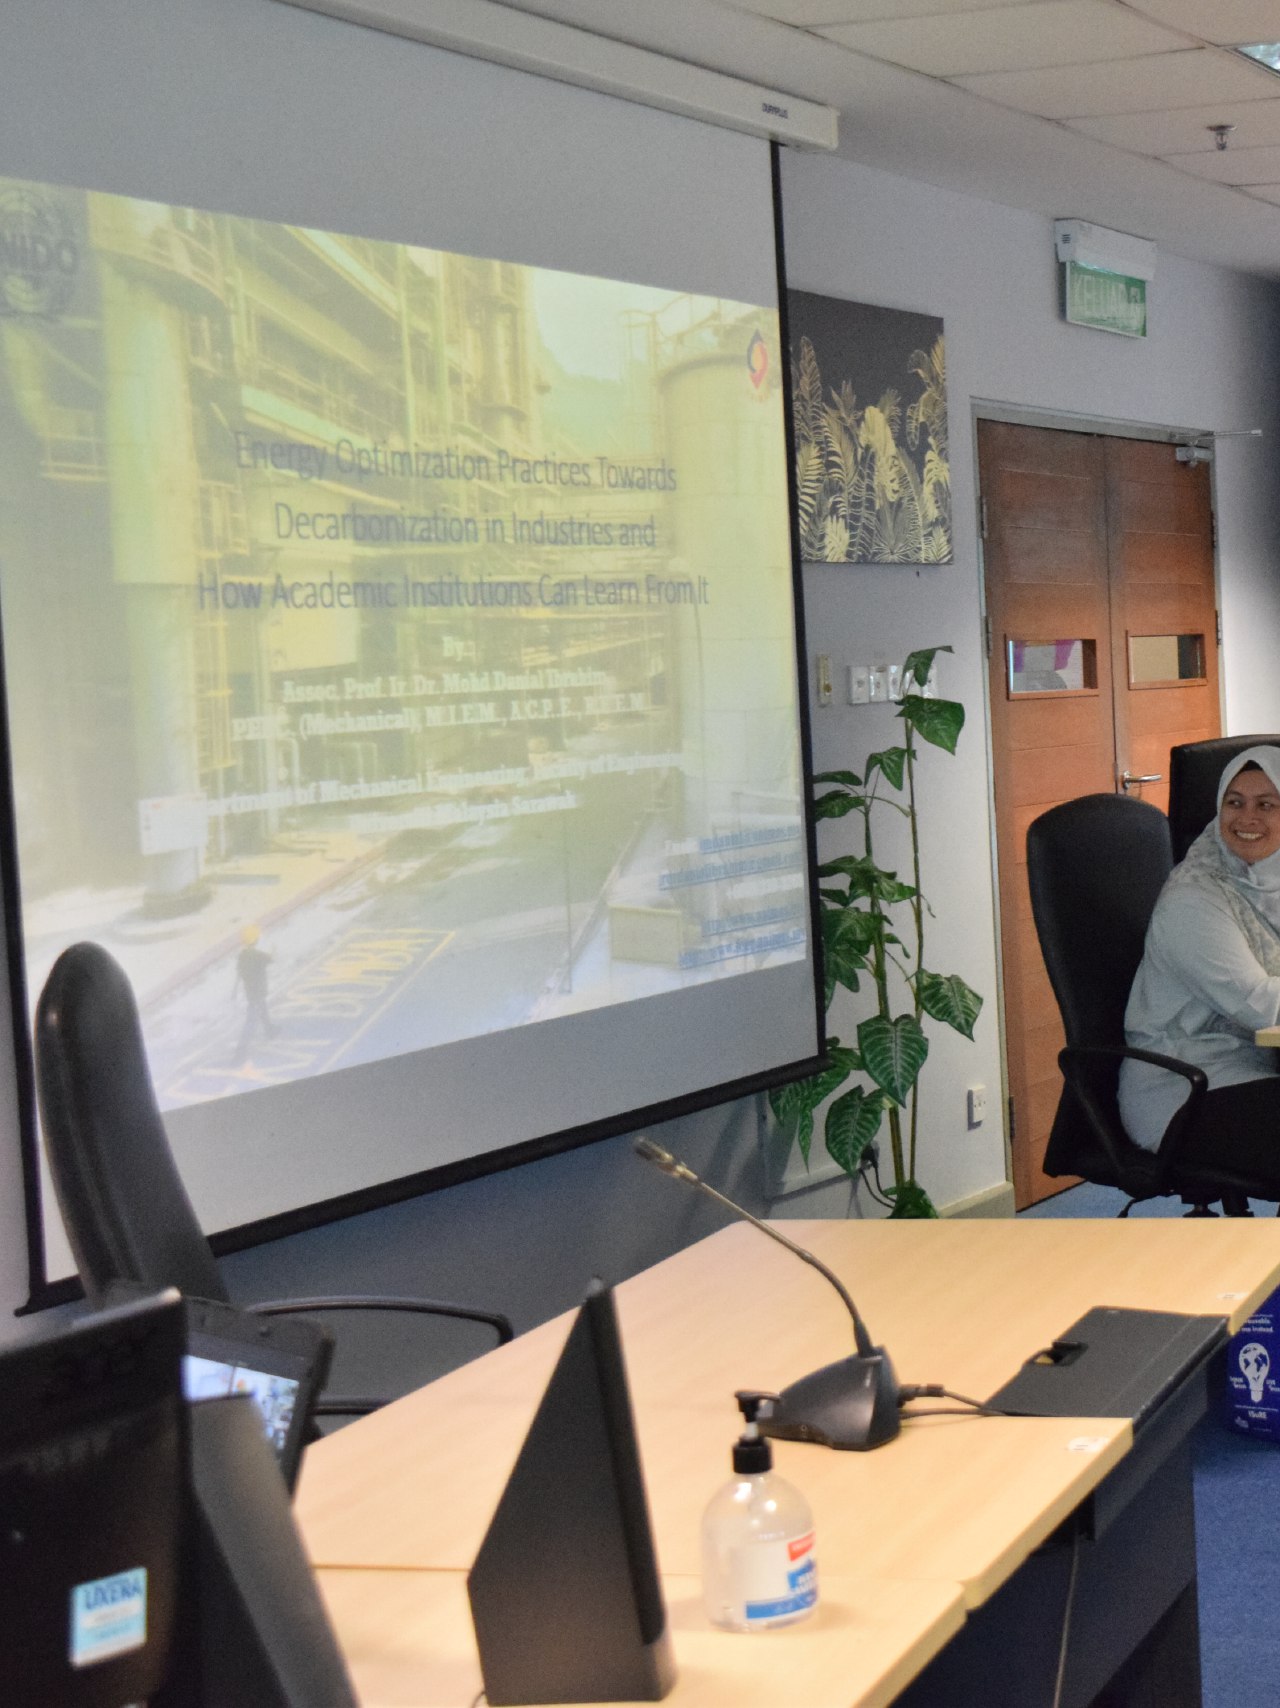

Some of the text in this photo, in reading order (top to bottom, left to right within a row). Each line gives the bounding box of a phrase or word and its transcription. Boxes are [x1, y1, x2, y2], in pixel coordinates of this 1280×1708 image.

[236, 431, 677, 491] Energy Optimization Practices Towards
[275, 501, 656, 548] Decarbonization in Industries and
[199, 570, 709, 609] How Academic Institutions Can Learn From It
